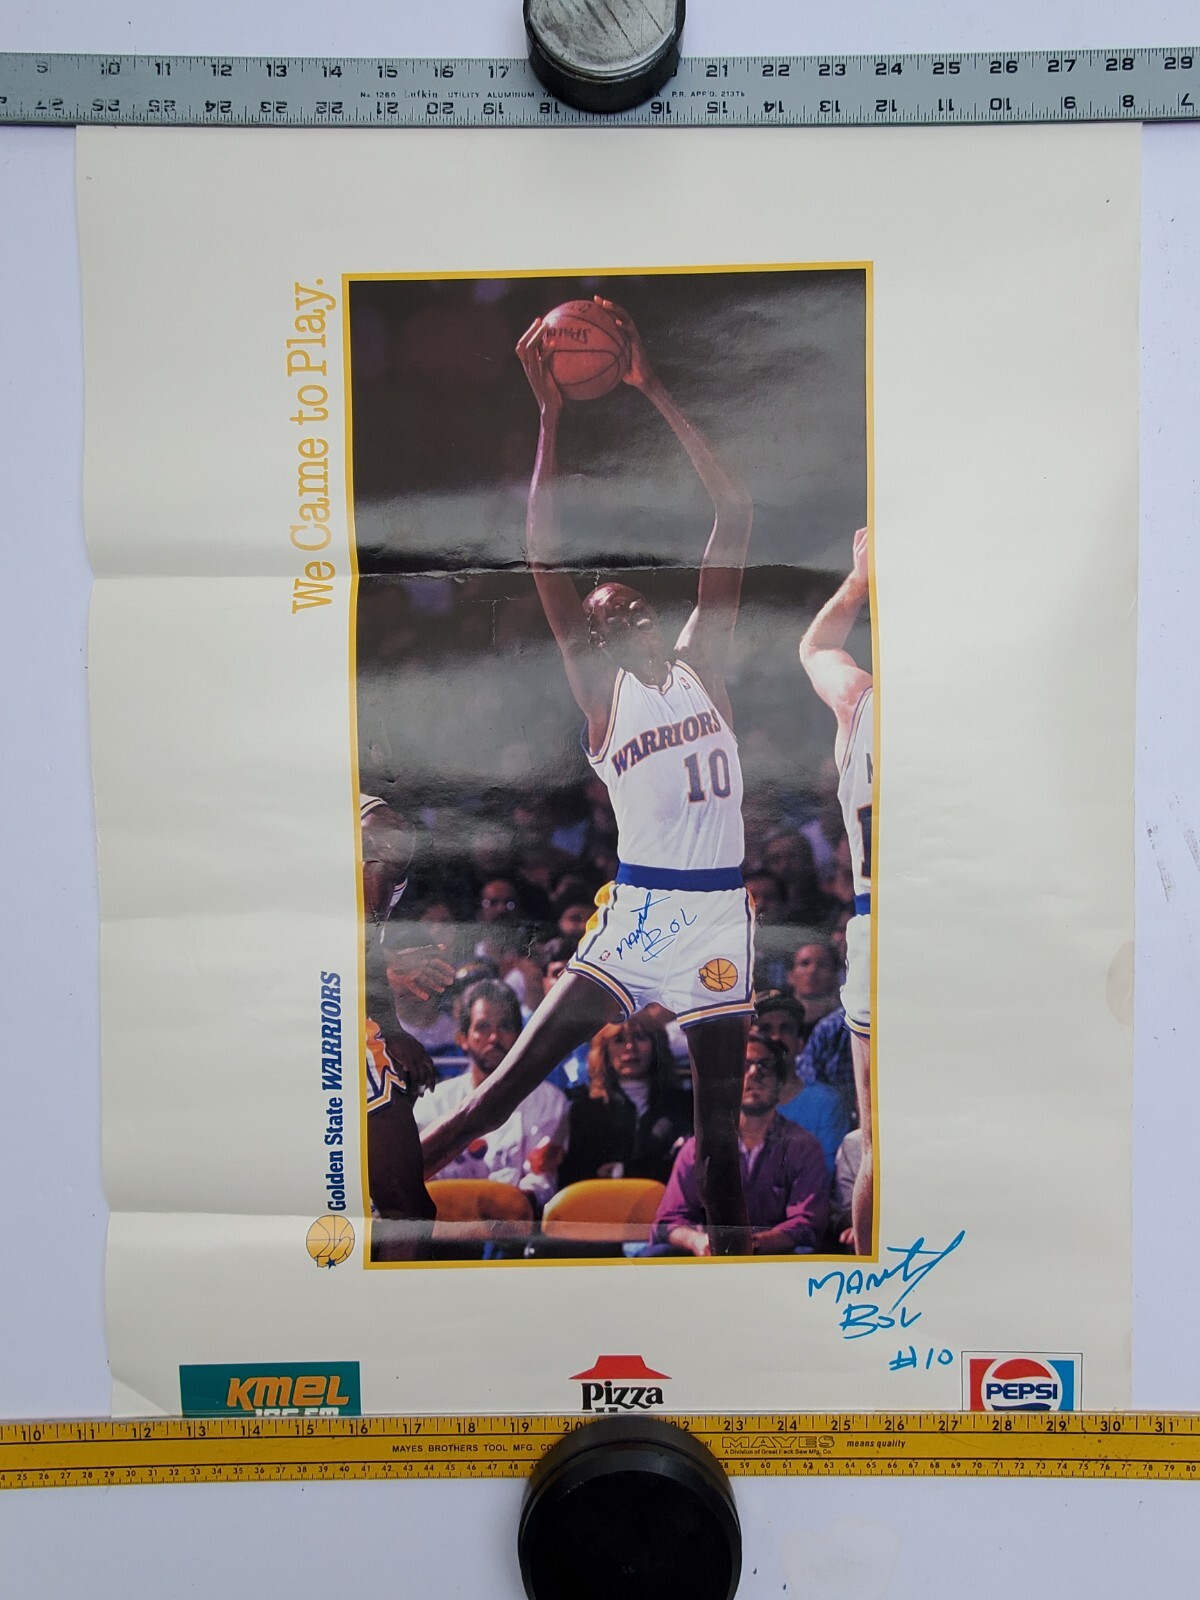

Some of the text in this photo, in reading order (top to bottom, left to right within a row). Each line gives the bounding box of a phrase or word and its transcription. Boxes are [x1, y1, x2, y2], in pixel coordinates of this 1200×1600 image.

[101, 62, 120, 75] 10
[155, 63, 171, 76] 11
[211, 64, 232, 77] 12
[267, 64, 288, 78] 13
[323, 66, 343, 78] 14
[378, 66, 398, 78] 15
[434, 66, 454, 79] 16
[489, 66, 510, 79] 17
[706, 65, 728, 78] 21
[762, 65, 790, 78] 22
[819, 64, 846, 77] 23
[875, 63, 903, 76] 24
[933, 62, 961, 75] 25
[990, 61, 1018, 74] 26
[1048, 59, 1076, 73] 27
[1106, 58, 1135, 71] 28
[1164, 57, 1193, 70] 29
[938, 99, 954, 112] 11
[990, 98, 1012, 111] 10
[1064, 96, 1076, 109] 9
[1122, 95, 1134, 108] 8
[1181, 93, 1194, 106] 7
[205, 101, 232, 113] 24
[261, 101, 288, 114] 23
[316, 102, 343, 114] 22
[377, 102, 398, 114] 21
[426, 102, 454, 115] 20
[483, 102, 504, 115] 19
[540, 102, 560, 114] 18
[651, 101, 672, 114] 16
[706, 101, 728, 114] 15
[764, 101, 784, 113] 14
[819, 100, 841, 113] 13
[876, 100, 898, 113] 12
[286, 278, 337, 615] We Came to Play.
[611, 708, 722, 778] WARRIORS
[684, 747, 732, 804] 10
[320, 970, 346, 1212] Golden State WARRIORS
[581, 1381, 664, 1410] Pizza
[986, 1383, 1058, 1400] PEPSI
[22, 1430, 41, 1441] 10
[77, 1429, 95, 1440] 11
[132, 1427, 152, 1438] 12
[187, 1426, 206, 1437] 13
[241, 1425, 260, 1436] 14
[295, 1424, 314, 1435] 15
[350, 1424, 368, 1434] 16
[403, 1423, 422, 1434] 17
[457, 1422, 476, 1433] 18
[511, 1422, 529, 1432] 19
[724, 1420, 744, 1431] 23
[777, 1420, 797, 1431] 24
[831, 1420, 851, 1431] 25
[885, 1420, 905, 1431] 26
[939, 1420, 959, 1431] 27
[992, 1420, 1012, 1431] 28
[1047, 1420, 1067, 1431] 29
[1100, 1420, 1121, 1431] 30
[1155, 1422, 1173, 1432] 31
[429, 1444, 478, 1452] BROTHERS
[484, 1444, 508, 1452] TOOL
[722, 1436, 835, 1449] MAYES
[877, 1439, 906, 1449] quality
